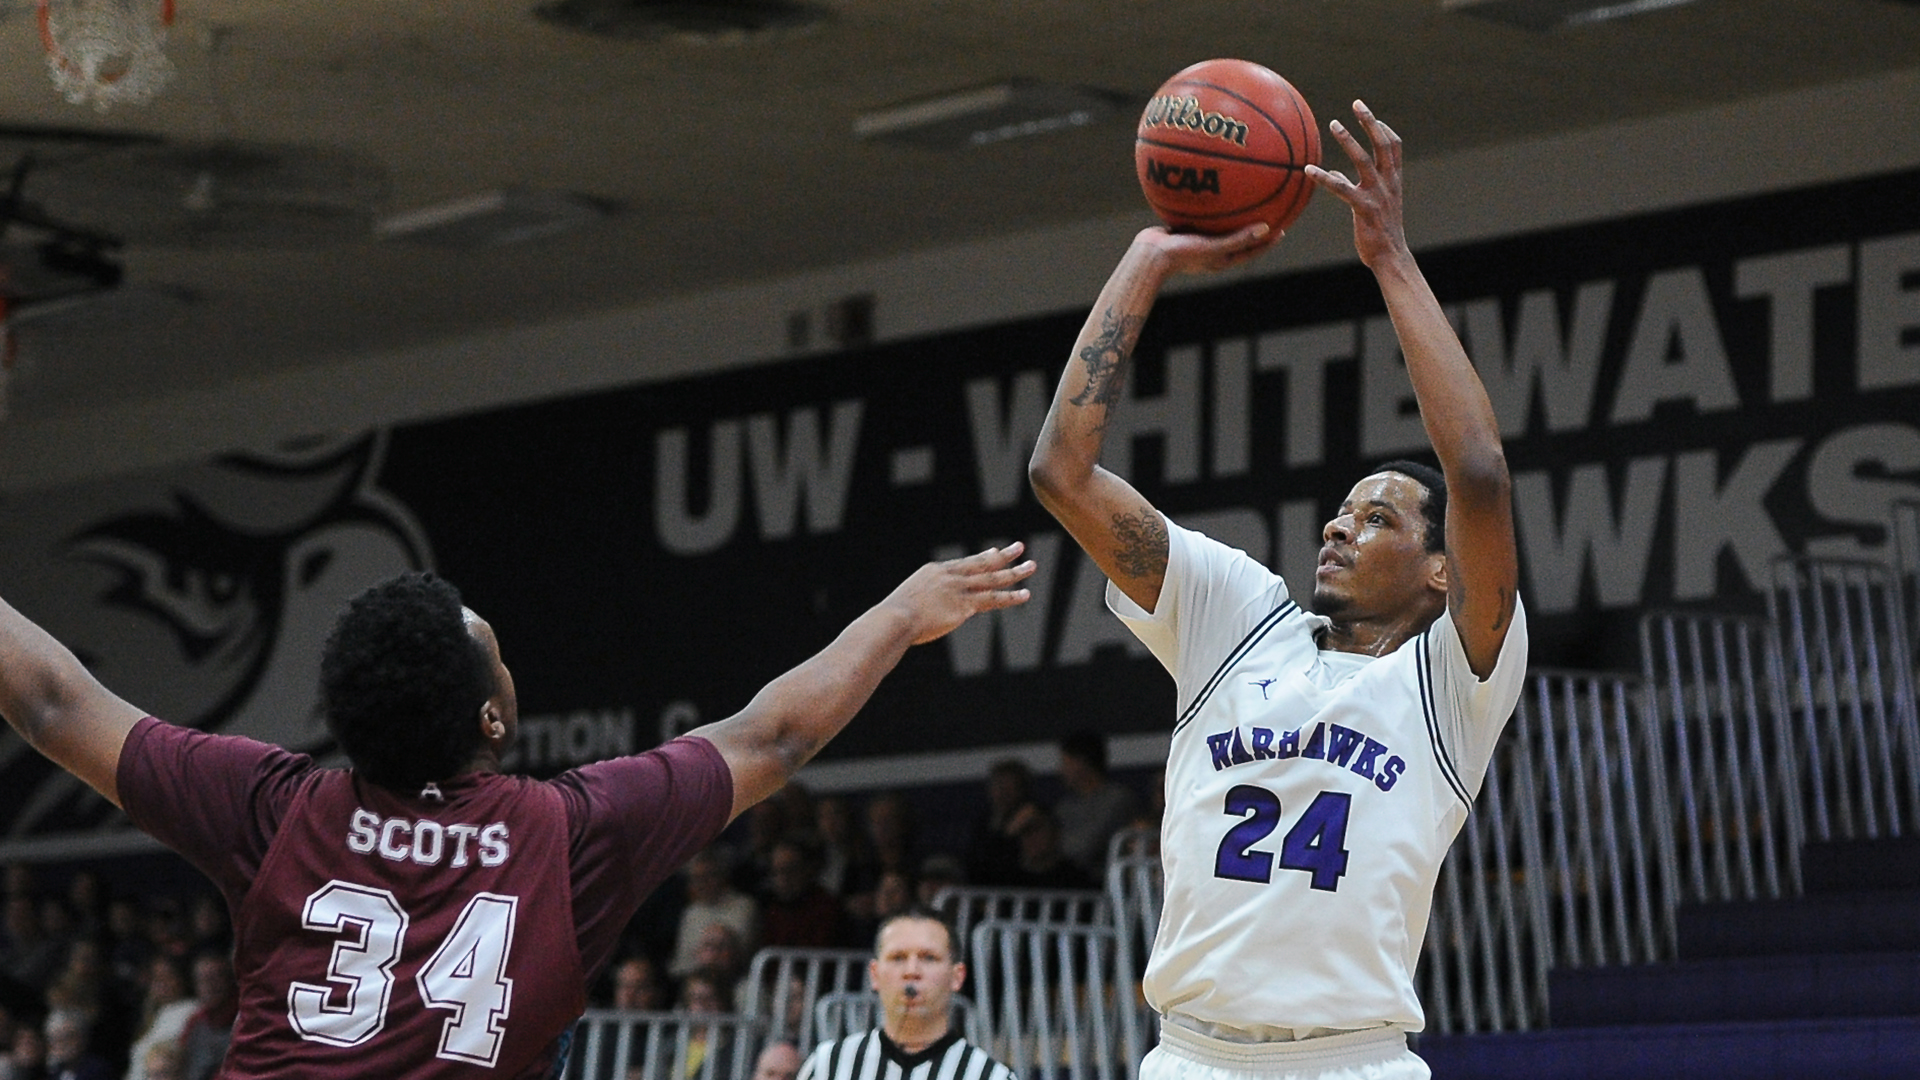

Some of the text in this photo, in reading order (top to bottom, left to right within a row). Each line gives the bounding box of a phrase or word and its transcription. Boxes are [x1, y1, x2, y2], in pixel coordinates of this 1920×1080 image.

[1145, 94, 1249, 147] Wilson
[1147, 157, 1220, 195] NCAA
[654, 400, 866, 557] UW
[501, 709, 636, 770] TION
[1206, 721, 1406, 792] WARHAWKS
[347, 806, 510, 869] SCOTS
[1213, 783, 1352, 893] 24
[287, 878, 519, 1069] 34
